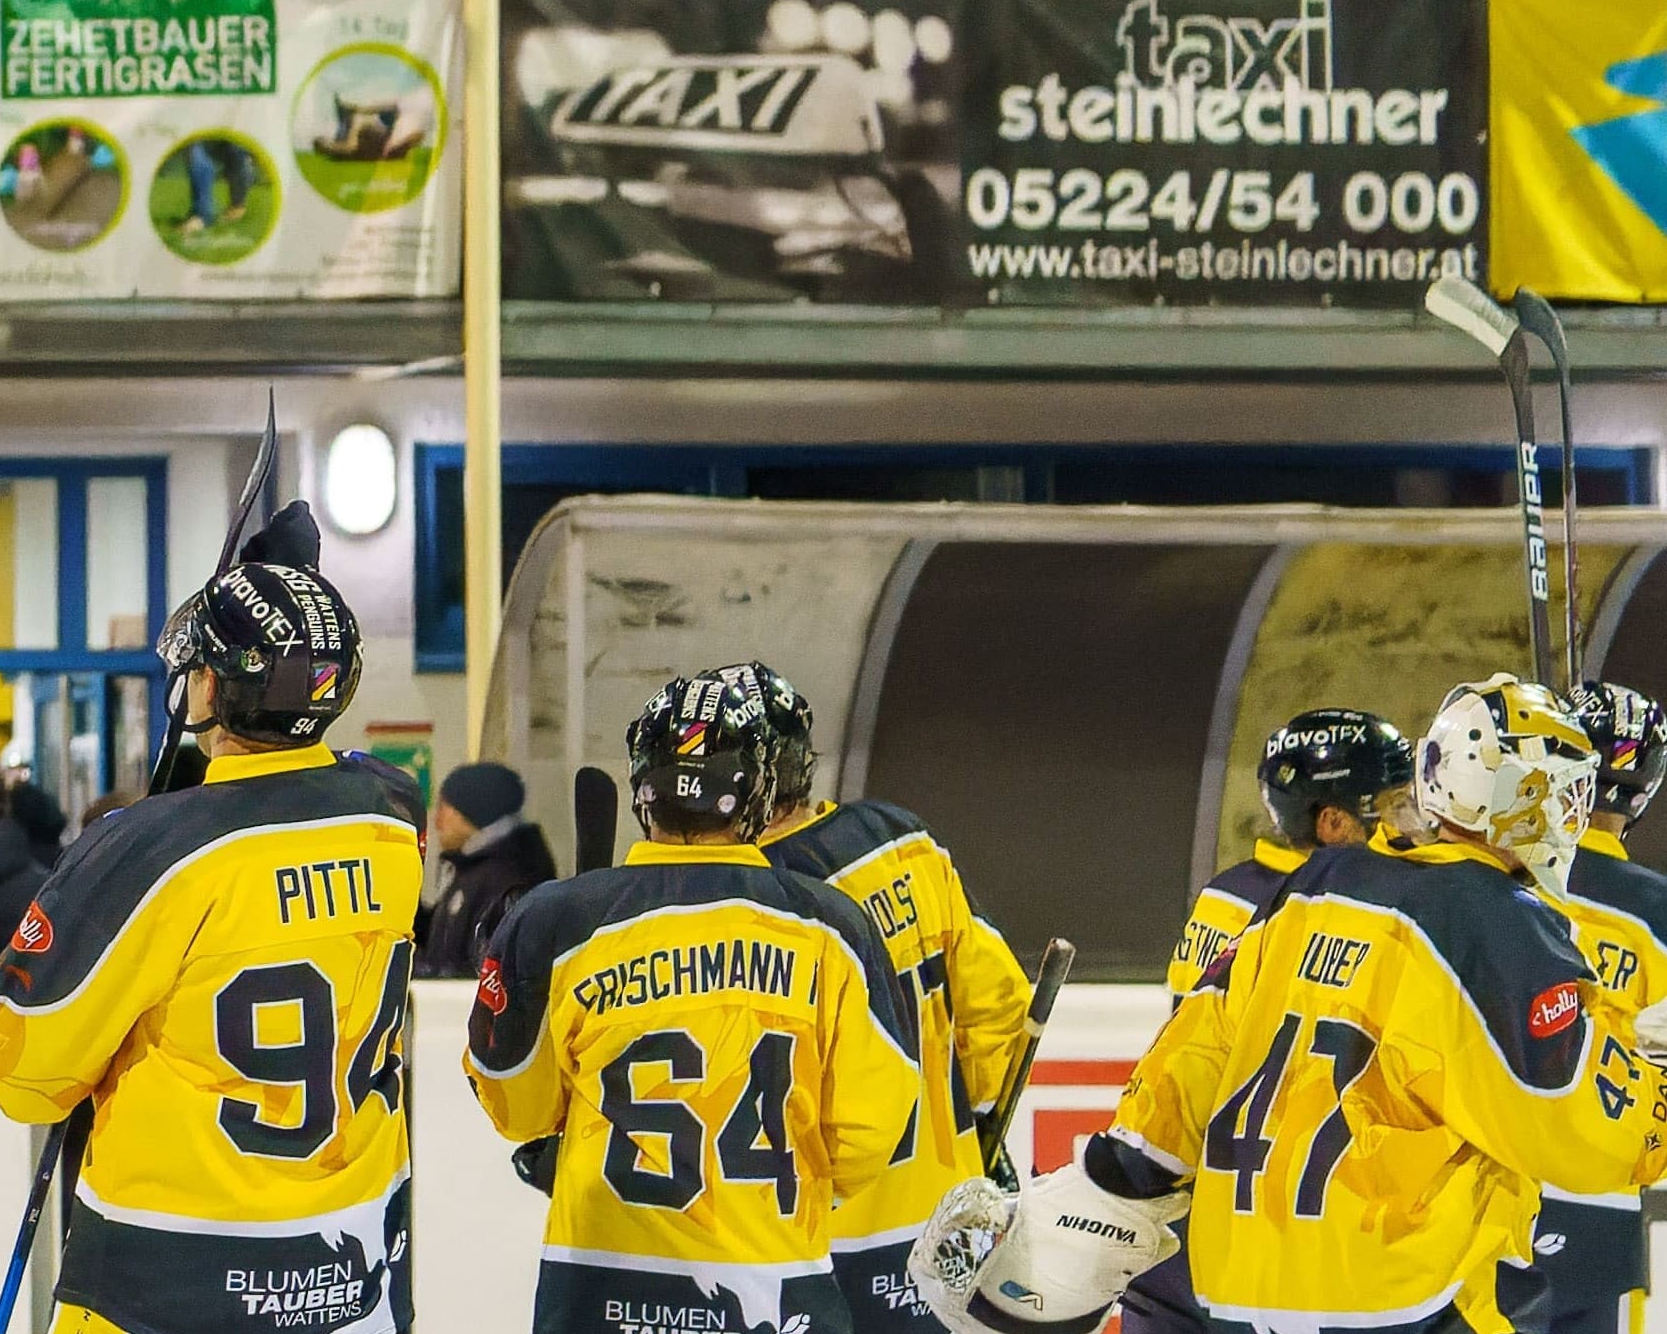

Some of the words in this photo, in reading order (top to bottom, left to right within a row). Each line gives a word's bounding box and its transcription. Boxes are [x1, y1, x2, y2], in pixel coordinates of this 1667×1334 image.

[7, 15, 270, 56] ZEHETBAUER
[5, 53, 274, 96] FERTIGRASEN
[998, 72, 1448, 146] steinlechner
[968, 167, 1320, 233] 05224/54
[1343, 172, 1478, 235] 000
[968, 239, 1478, 286] www.taxi-steinlechner.at
[1520, 442, 1549, 603] BAUER
[223, 565, 305, 657] bravoTEX
[297, 594, 326, 651] PENGUINS
[313, 593, 342, 651] WATTENS
[290, 717, 319, 736] 94
[676, 774, 703, 799] 64
[275, 858, 382, 924] PITTL
[213, 959, 405, 1161] 94
[599, 1026, 801, 1218] 64
[1202, 1010, 1381, 1220] 47
[1055, 1212, 1140, 1245] VAUGHN
[225, 1260, 353, 1295] BLUMEN
[240, 1278, 365, 1317] TAUBER
[273, 1299, 365, 1329] WATTENS
[605, 1298, 727, 1331] BLUMEN
